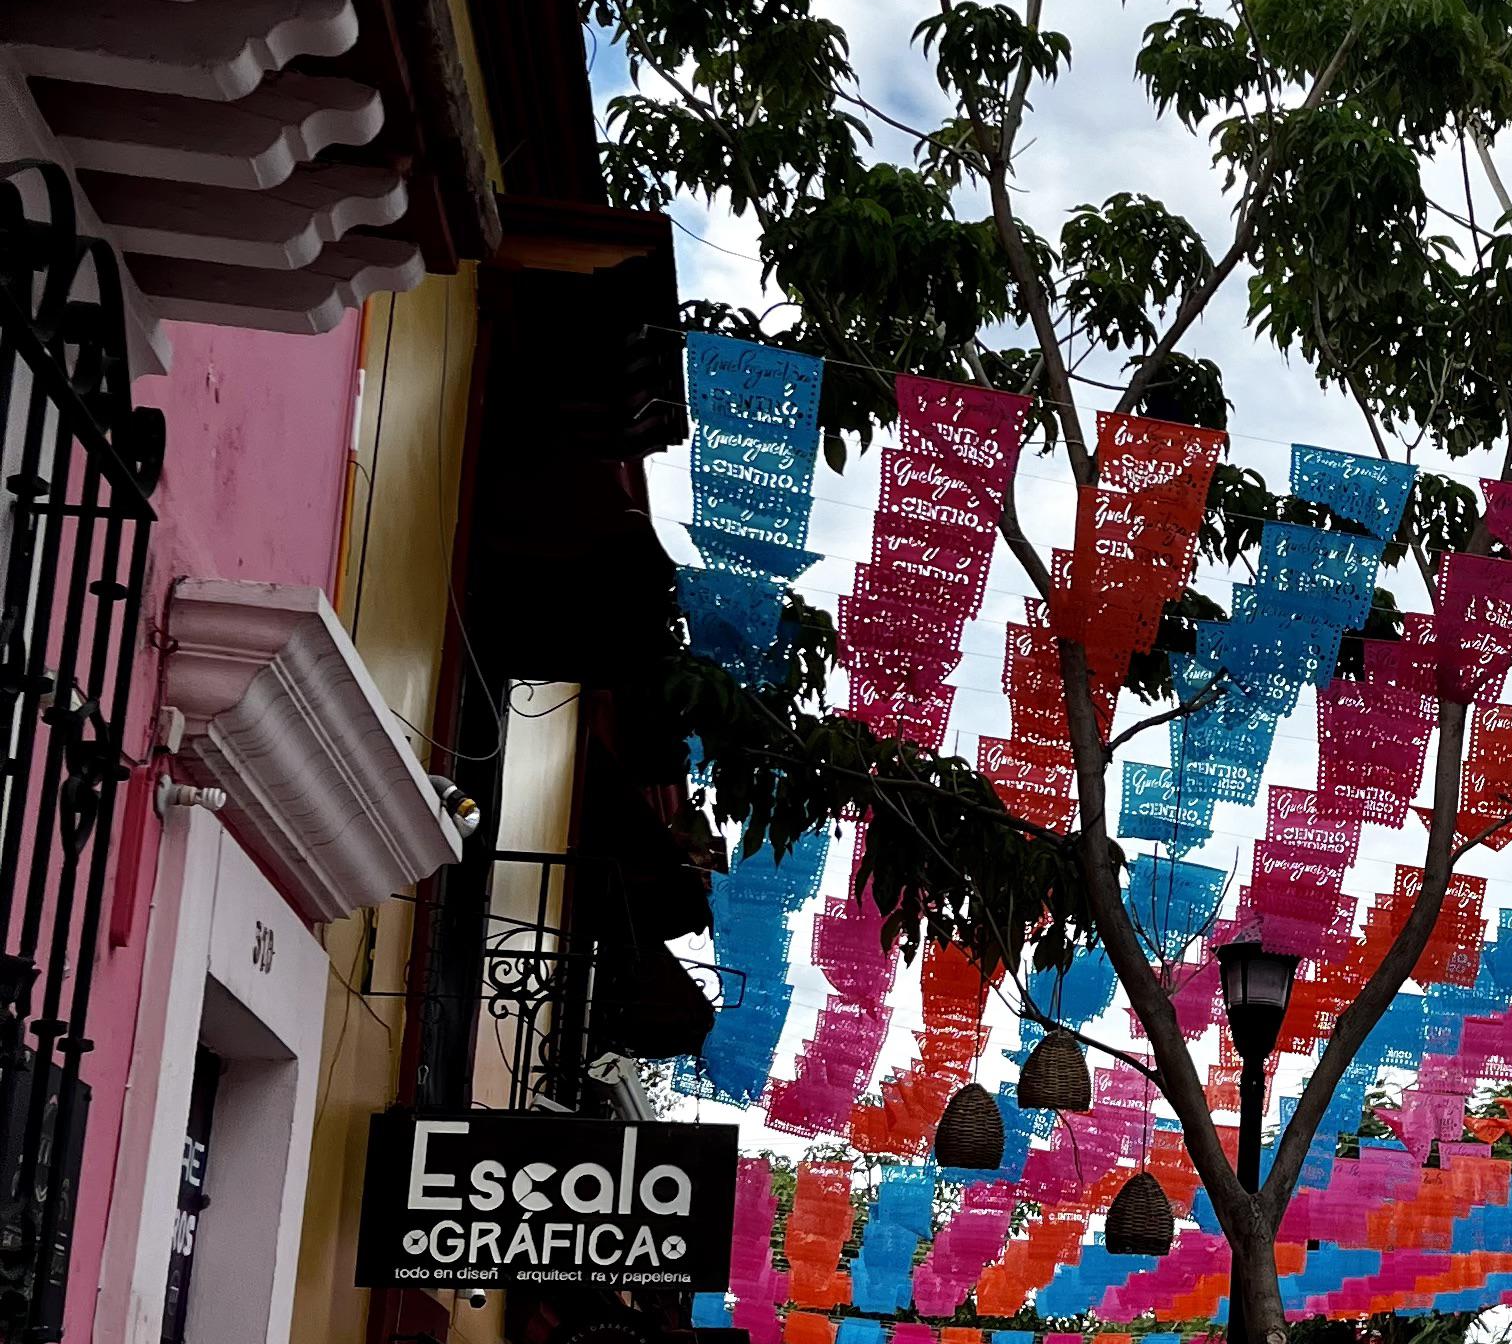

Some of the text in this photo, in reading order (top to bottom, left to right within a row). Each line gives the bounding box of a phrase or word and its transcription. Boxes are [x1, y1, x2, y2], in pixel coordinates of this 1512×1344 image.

[712, 459, 793, 488] CENTRO
[902, 497, 979, 527] CENTRO
[1187, 761, 1247, 779] CENTRO
[1335, 785, 1396, 804] CENTRO
[1283, 827, 1346, 843] CENTRO
[408, 1121, 692, 1217] Escala
[430, 1212, 660, 1266] GRÁFICA
[395, 1268, 430, 1280] todo
[434, 1269, 452, 1279] en
[457, 1267, 499, 1280] diseñ
[609, 1272, 619, 1284] y
